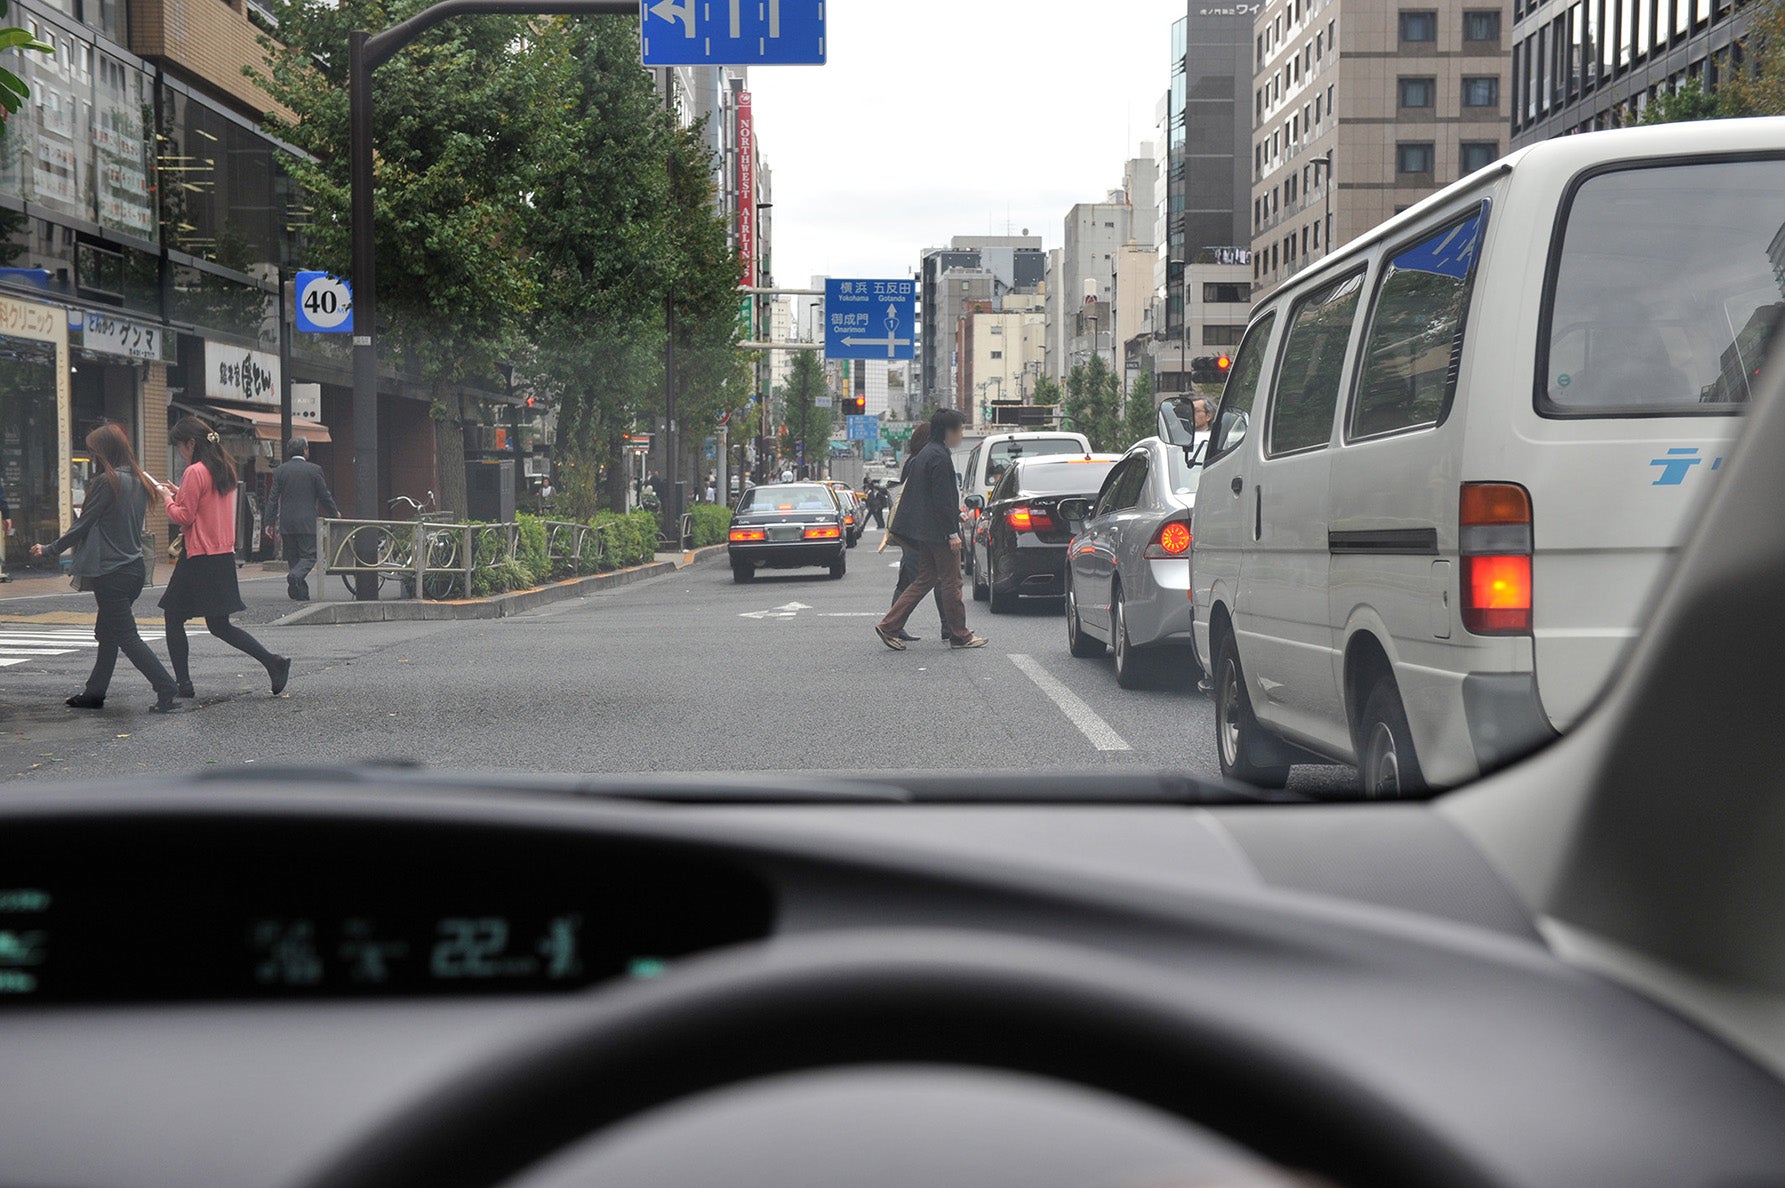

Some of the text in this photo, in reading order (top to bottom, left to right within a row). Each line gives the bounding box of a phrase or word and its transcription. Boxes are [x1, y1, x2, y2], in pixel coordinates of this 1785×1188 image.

[740, 119, 750, 199] NORTHWEST
[840, 281, 911, 294] 横浜 五反田
[304, 290, 337, 314] 40
[831, 313, 869, 326] 御成門
